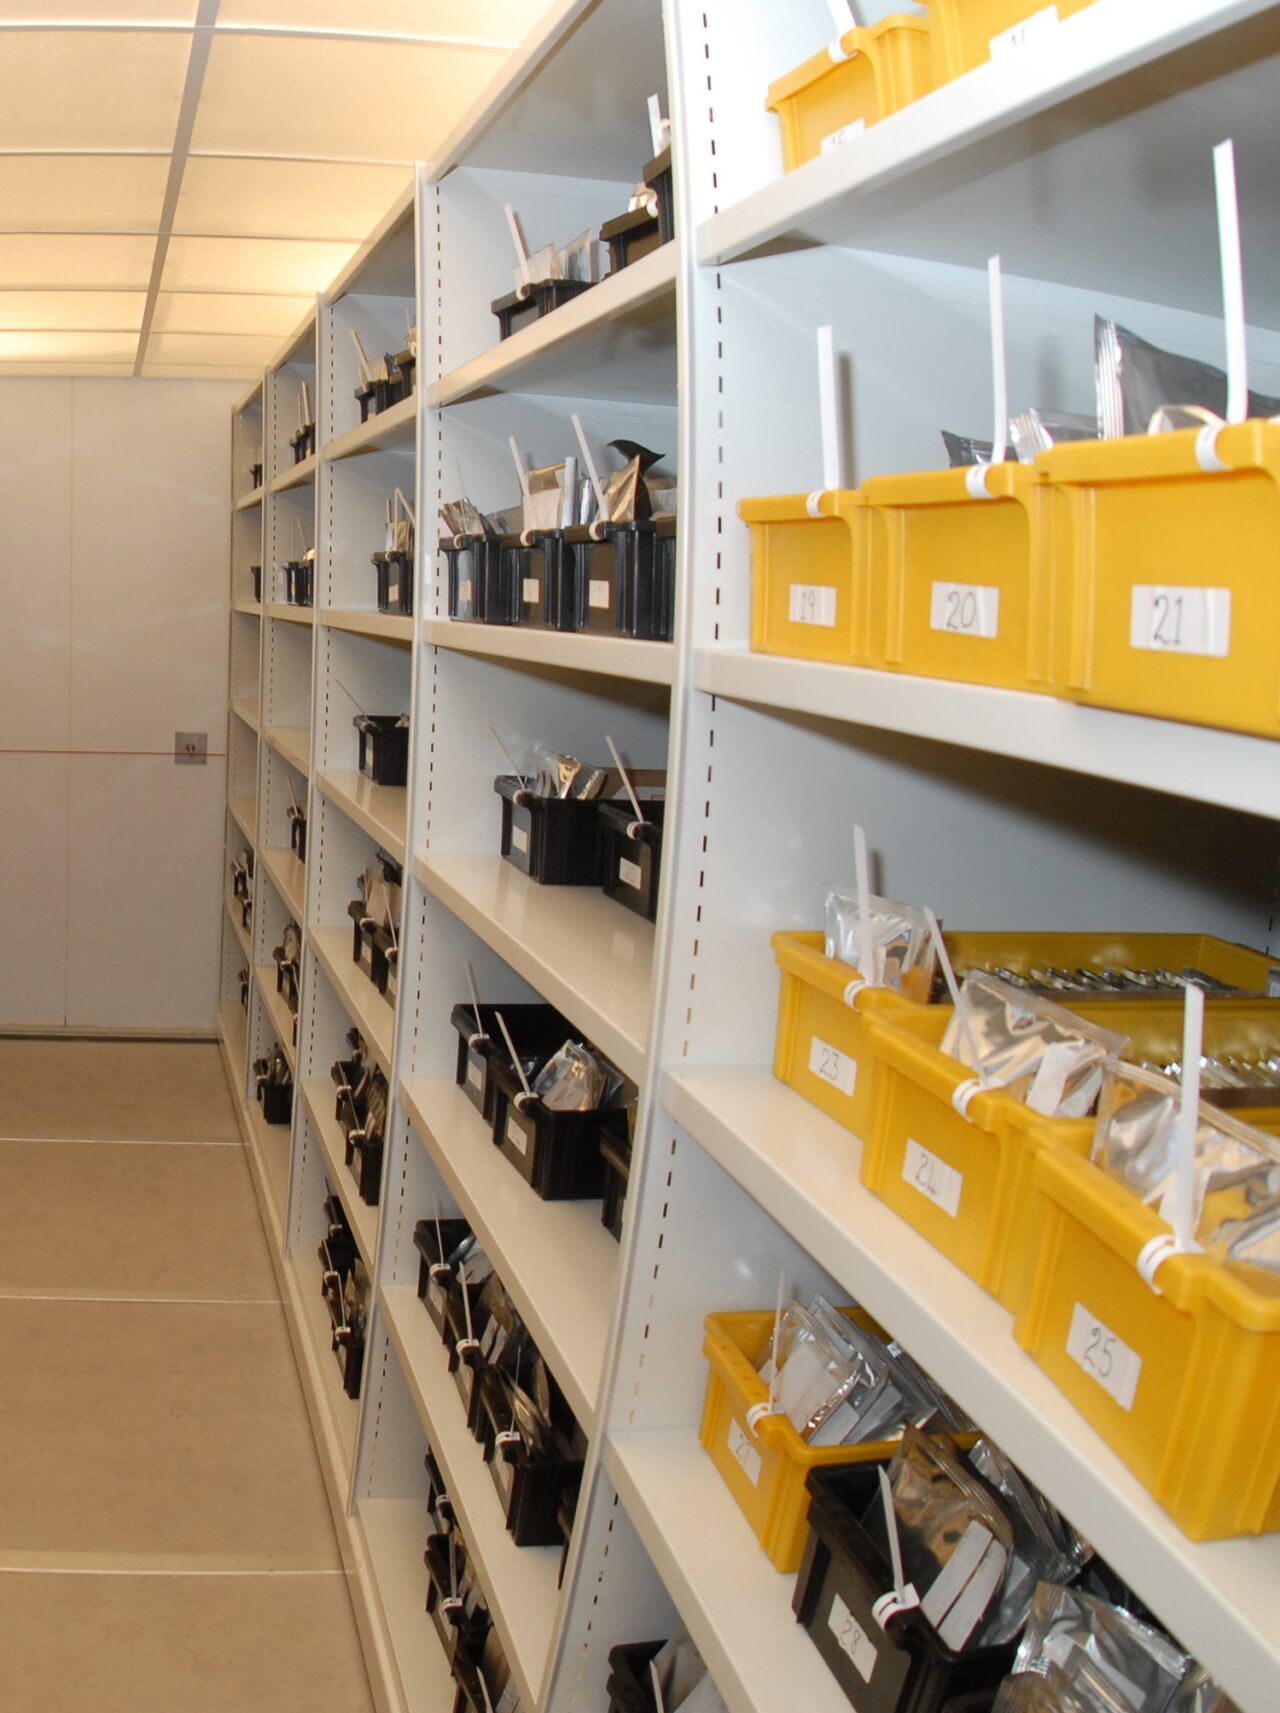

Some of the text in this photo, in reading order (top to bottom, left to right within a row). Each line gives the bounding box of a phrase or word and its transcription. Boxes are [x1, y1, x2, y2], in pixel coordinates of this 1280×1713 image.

[800, 589, 816, 622] 19
[946, 590, 978, 630] 20
[1152, 593, 1183, 646] 21
[818, 1047, 841, 1082] 23
[1082, 1326, 1117, 1379] 25
[838, 1618, 862, 1656] 28
